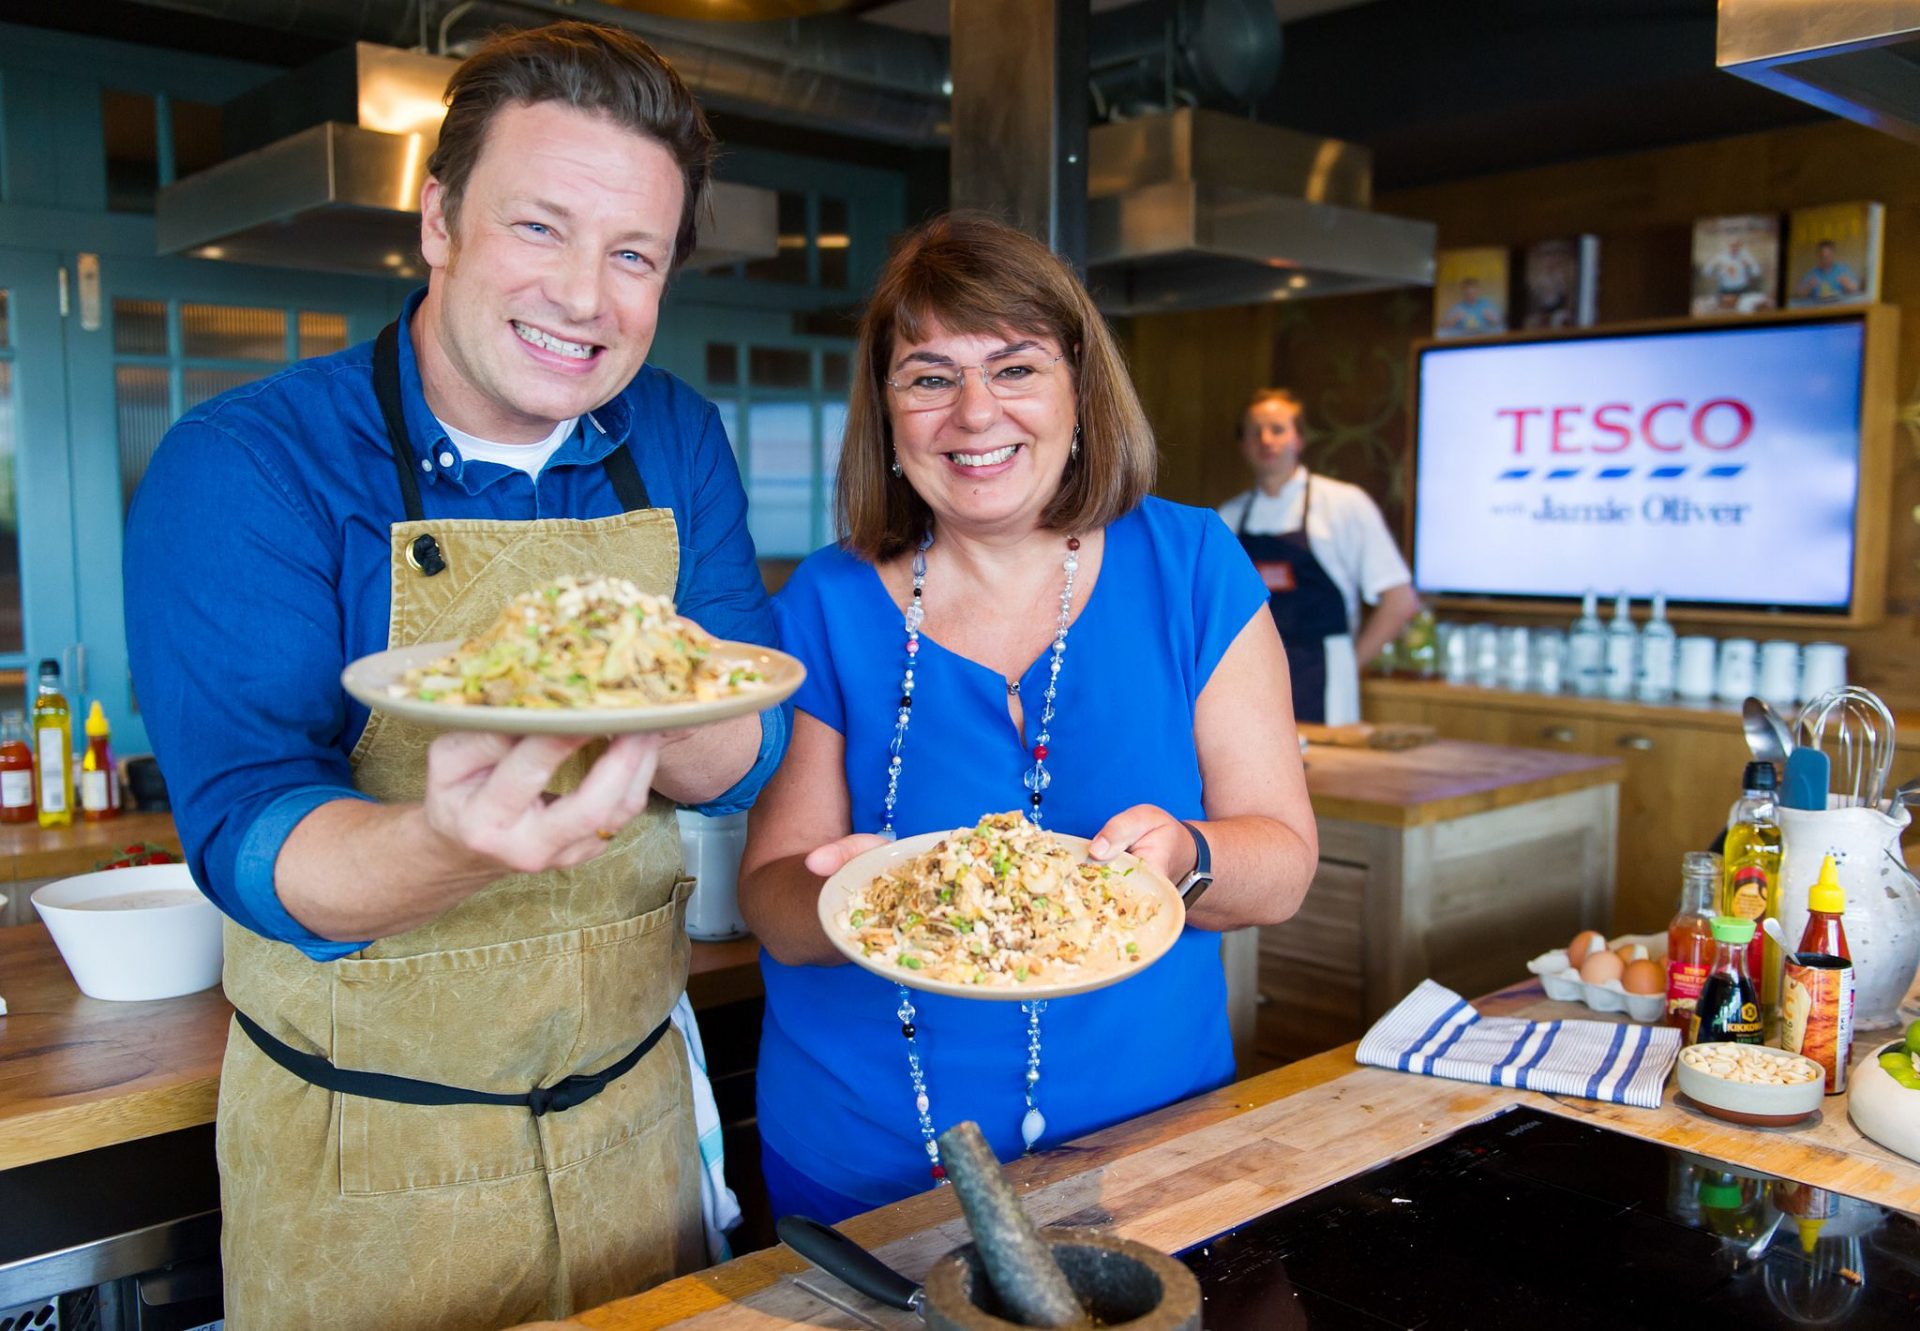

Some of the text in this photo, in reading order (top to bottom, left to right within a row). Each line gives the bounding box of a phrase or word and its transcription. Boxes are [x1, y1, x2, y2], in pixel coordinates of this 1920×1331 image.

[1497, 397, 1754, 454] TESCO
[1532, 494, 1632, 523] Jamie
[1642, 492, 1750, 524] Oliver
